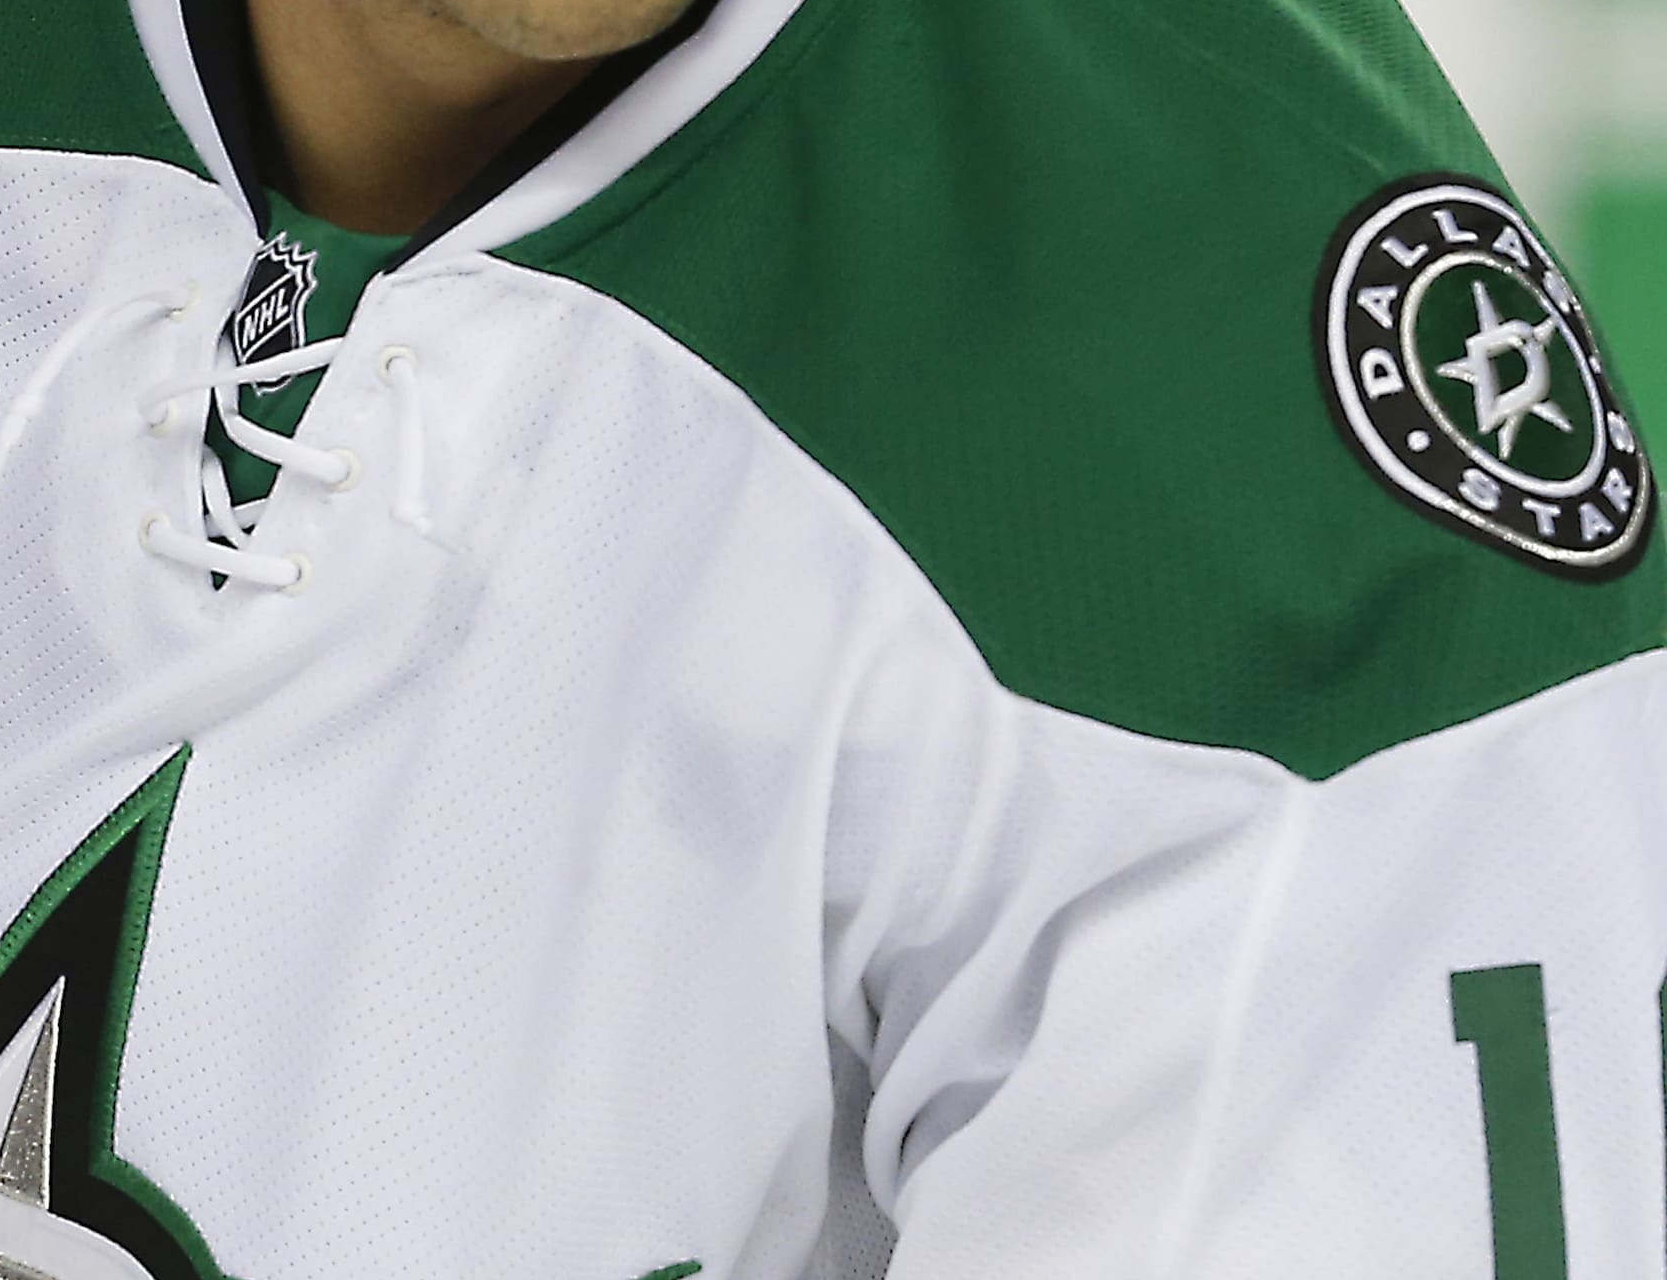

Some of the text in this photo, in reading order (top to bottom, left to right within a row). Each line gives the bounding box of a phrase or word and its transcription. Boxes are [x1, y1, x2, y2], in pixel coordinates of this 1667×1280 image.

[242, 288, 289, 349] NHL
[1357, 208, 1571, 400] DALLAS
[1457, 410, 1636, 543] STARS
